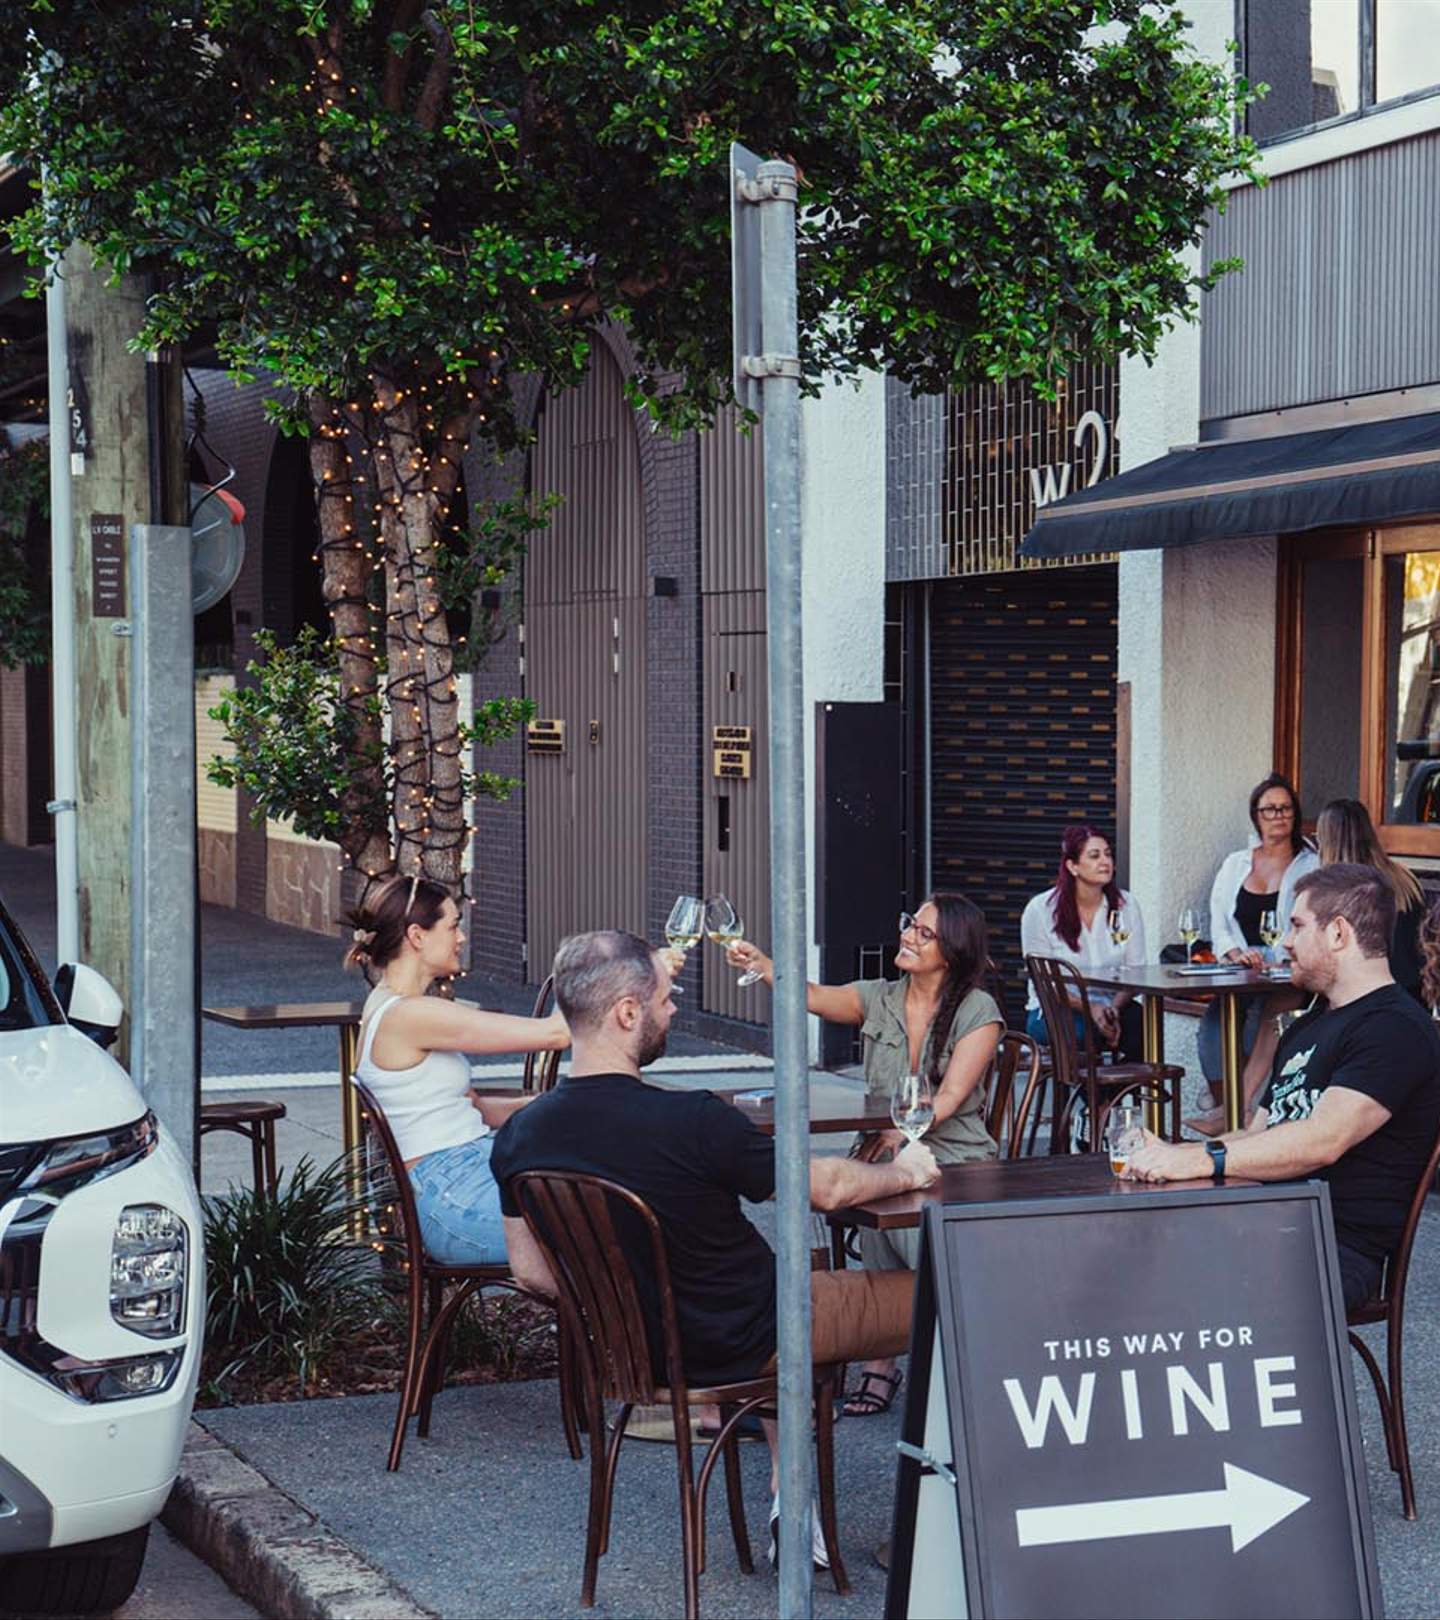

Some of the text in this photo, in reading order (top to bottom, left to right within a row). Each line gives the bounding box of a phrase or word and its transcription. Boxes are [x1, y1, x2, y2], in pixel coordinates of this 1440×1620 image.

[1044, 1326, 1254, 1361] THIS WAY FOR
[1002, 1355, 1303, 1449] WINE
